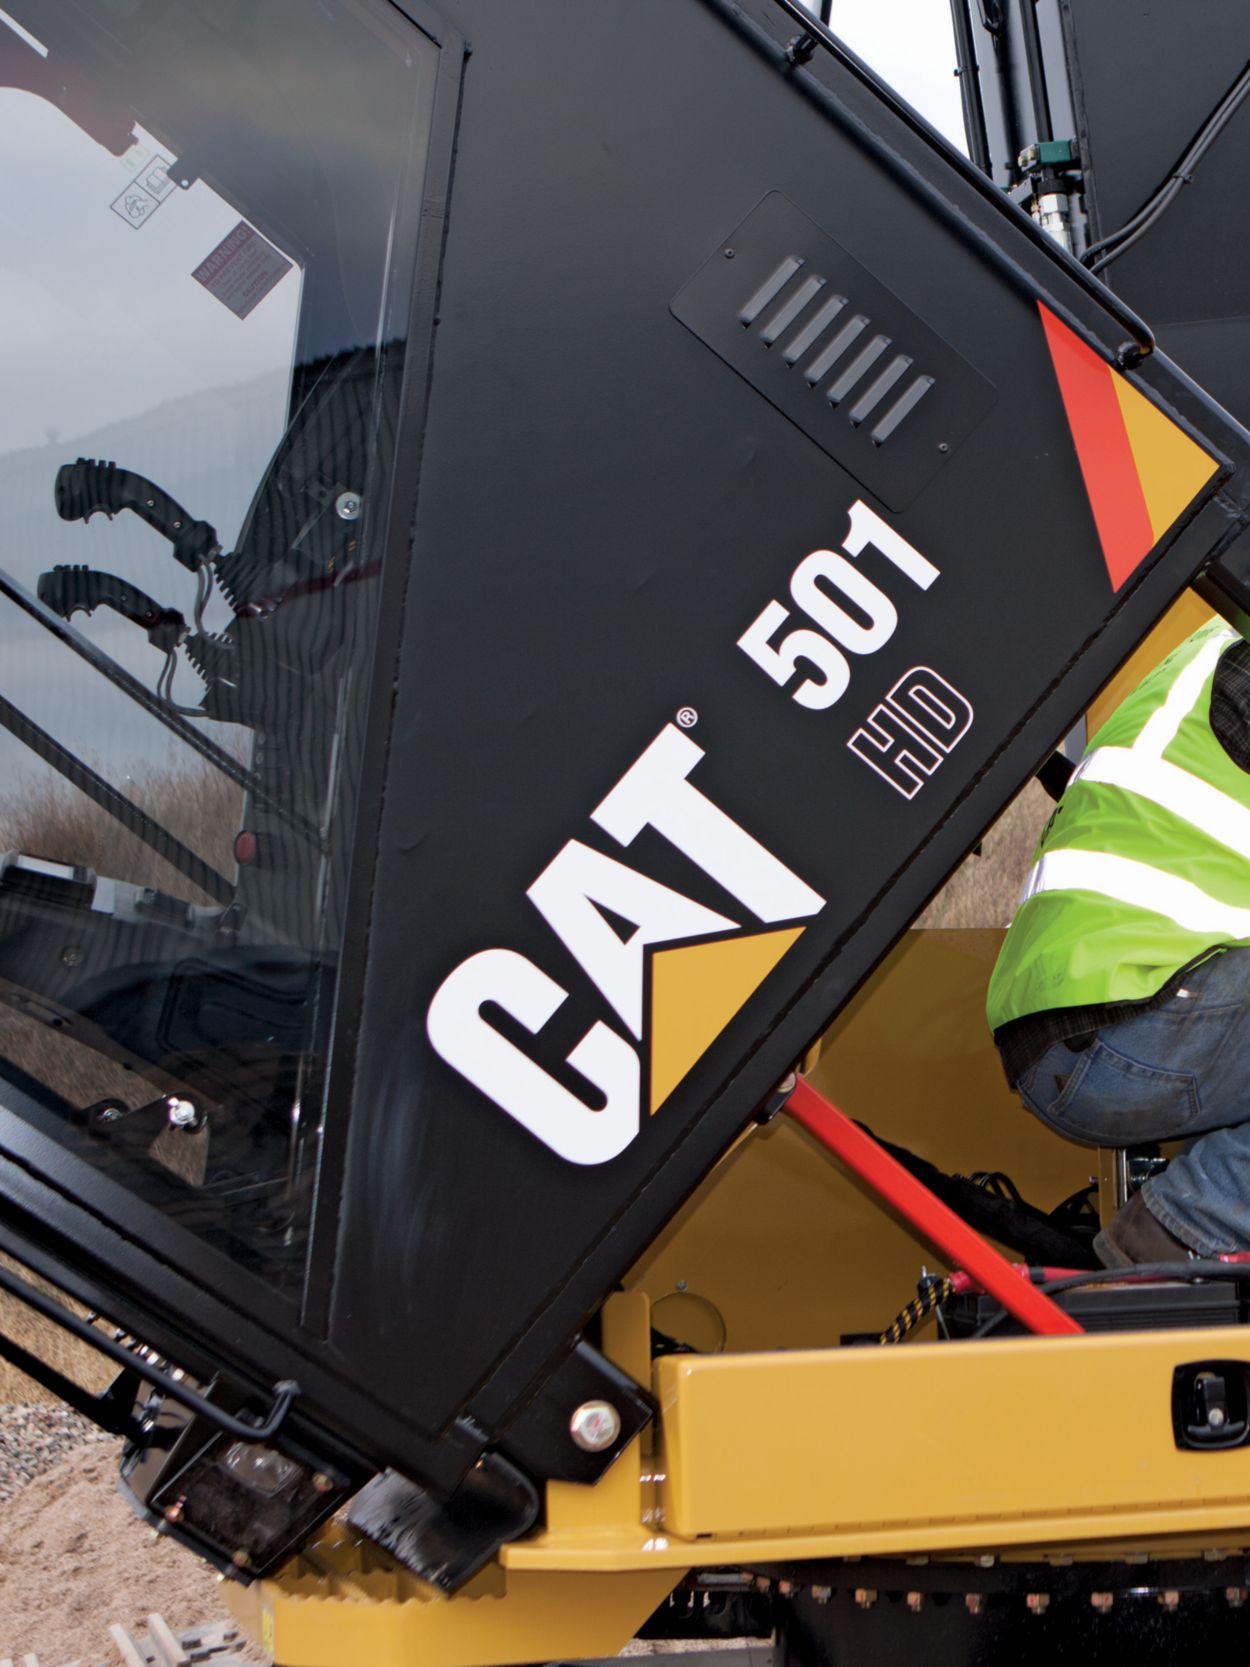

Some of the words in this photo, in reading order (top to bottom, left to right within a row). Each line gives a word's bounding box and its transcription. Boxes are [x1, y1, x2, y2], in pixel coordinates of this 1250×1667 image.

[195, 224, 251, 282] WARNING!
[737, 499, 941, 710] 501
[846, 666, 974, 801] HD
